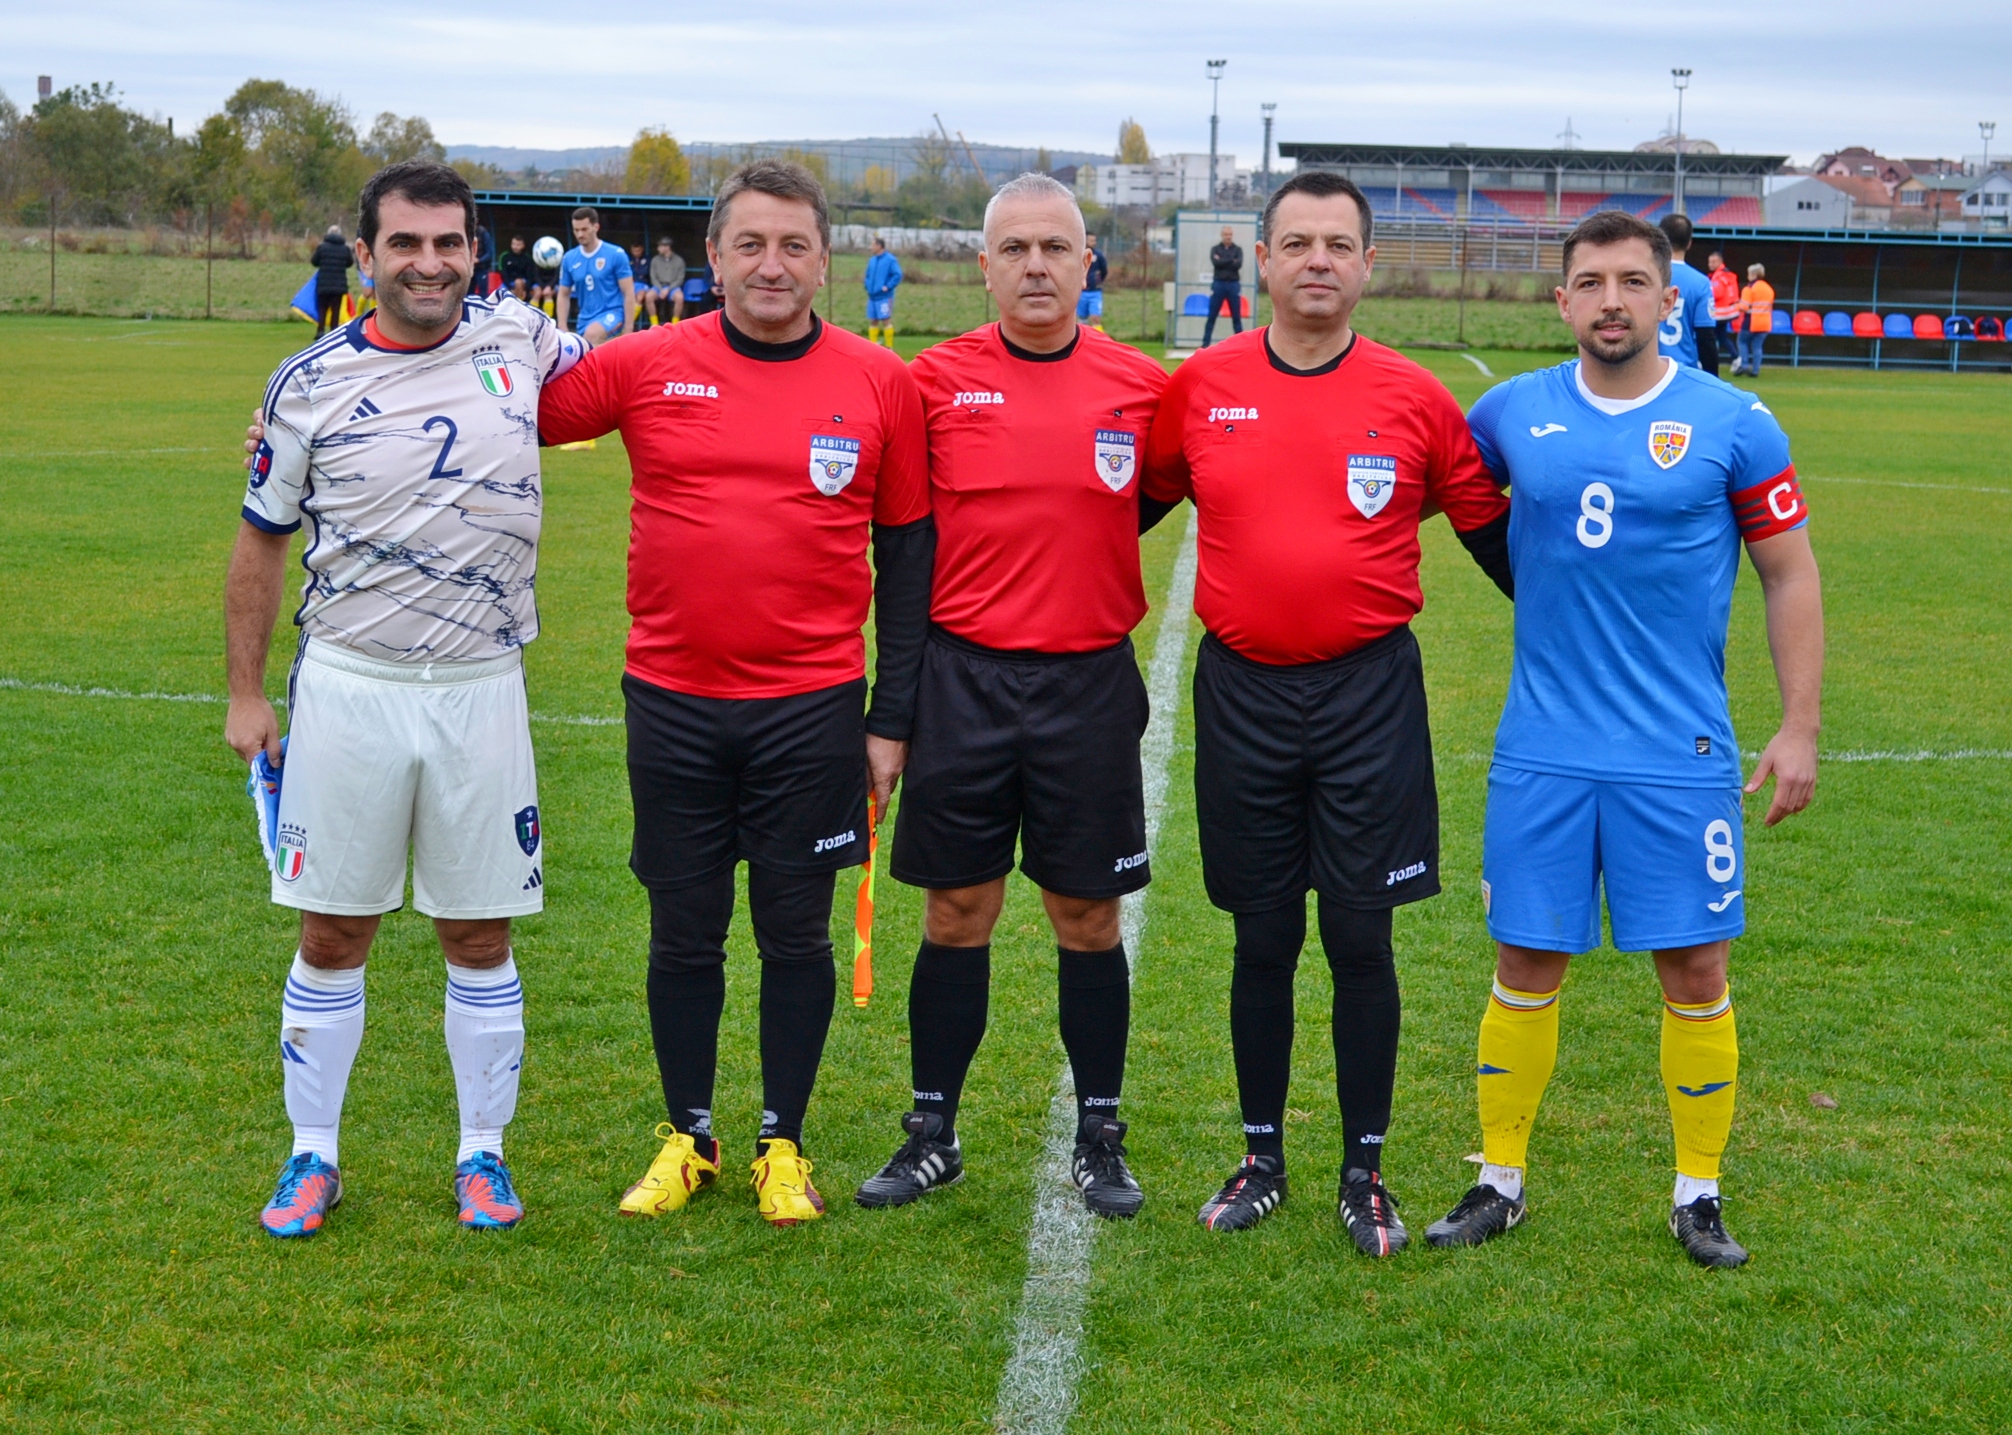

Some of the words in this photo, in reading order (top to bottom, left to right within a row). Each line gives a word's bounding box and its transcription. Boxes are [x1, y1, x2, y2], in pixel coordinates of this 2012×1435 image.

[585, 274, 595, 291] 9
[476, 356, 503, 367] ITALIA
[811, 437, 859, 451] ARBITRU
[1096, 431, 1135, 444] ARBITRU
[422, 415, 463, 480] 2
[1349, 457, 1395, 469] ARBITRU
[824, 483, 837, 491] FRF
[1110, 476, 1122, 485] FRF
[1364, 503, 1377, 511] FRF
[1767, 482, 1798, 520] C
[1576, 482, 1615, 549] 8
[281, 834, 304, 848] ITALIA
[1704, 819, 1736, 883] 8
